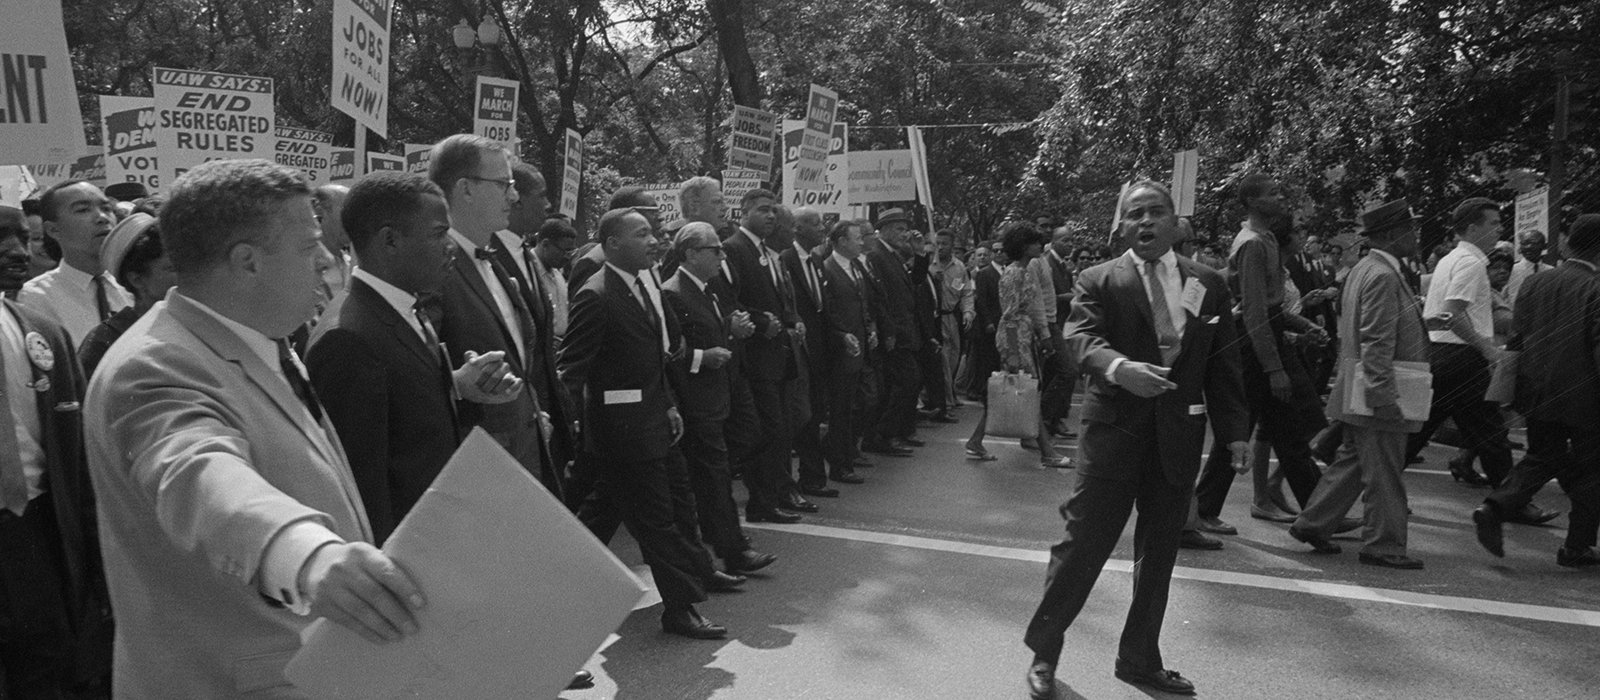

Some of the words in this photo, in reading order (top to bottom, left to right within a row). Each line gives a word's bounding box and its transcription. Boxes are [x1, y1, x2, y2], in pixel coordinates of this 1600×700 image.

[359, 0, 375, 16] OR
[343, 15, 383, 65] JOBS
[344, 47, 363, 69] FOR
[367, 65, 381, 84] ALL
[0, 53, 48, 124] NT
[160, 71, 206, 86] UAW
[209, 75, 270, 92] SAYS:
[341, 72, 383, 120] NOW!
[493, 87, 505, 98] WE
[176, 92, 252, 112] END
[481, 97, 513, 112] MARCH
[160, 109, 270, 134] SEGREGATED
[490, 111, 504, 119] FOR
[481, 126, 510, 141] JOBS
[735, 119, 761, 135] JOBS
[177, 132, 254, 152] RULES
[293, 130, 331, 143] SAYS:
[733, 135, 771, 152] FREEDOM
[275, 141, 318, 155] END
[383, 161, 394, 170] WE
